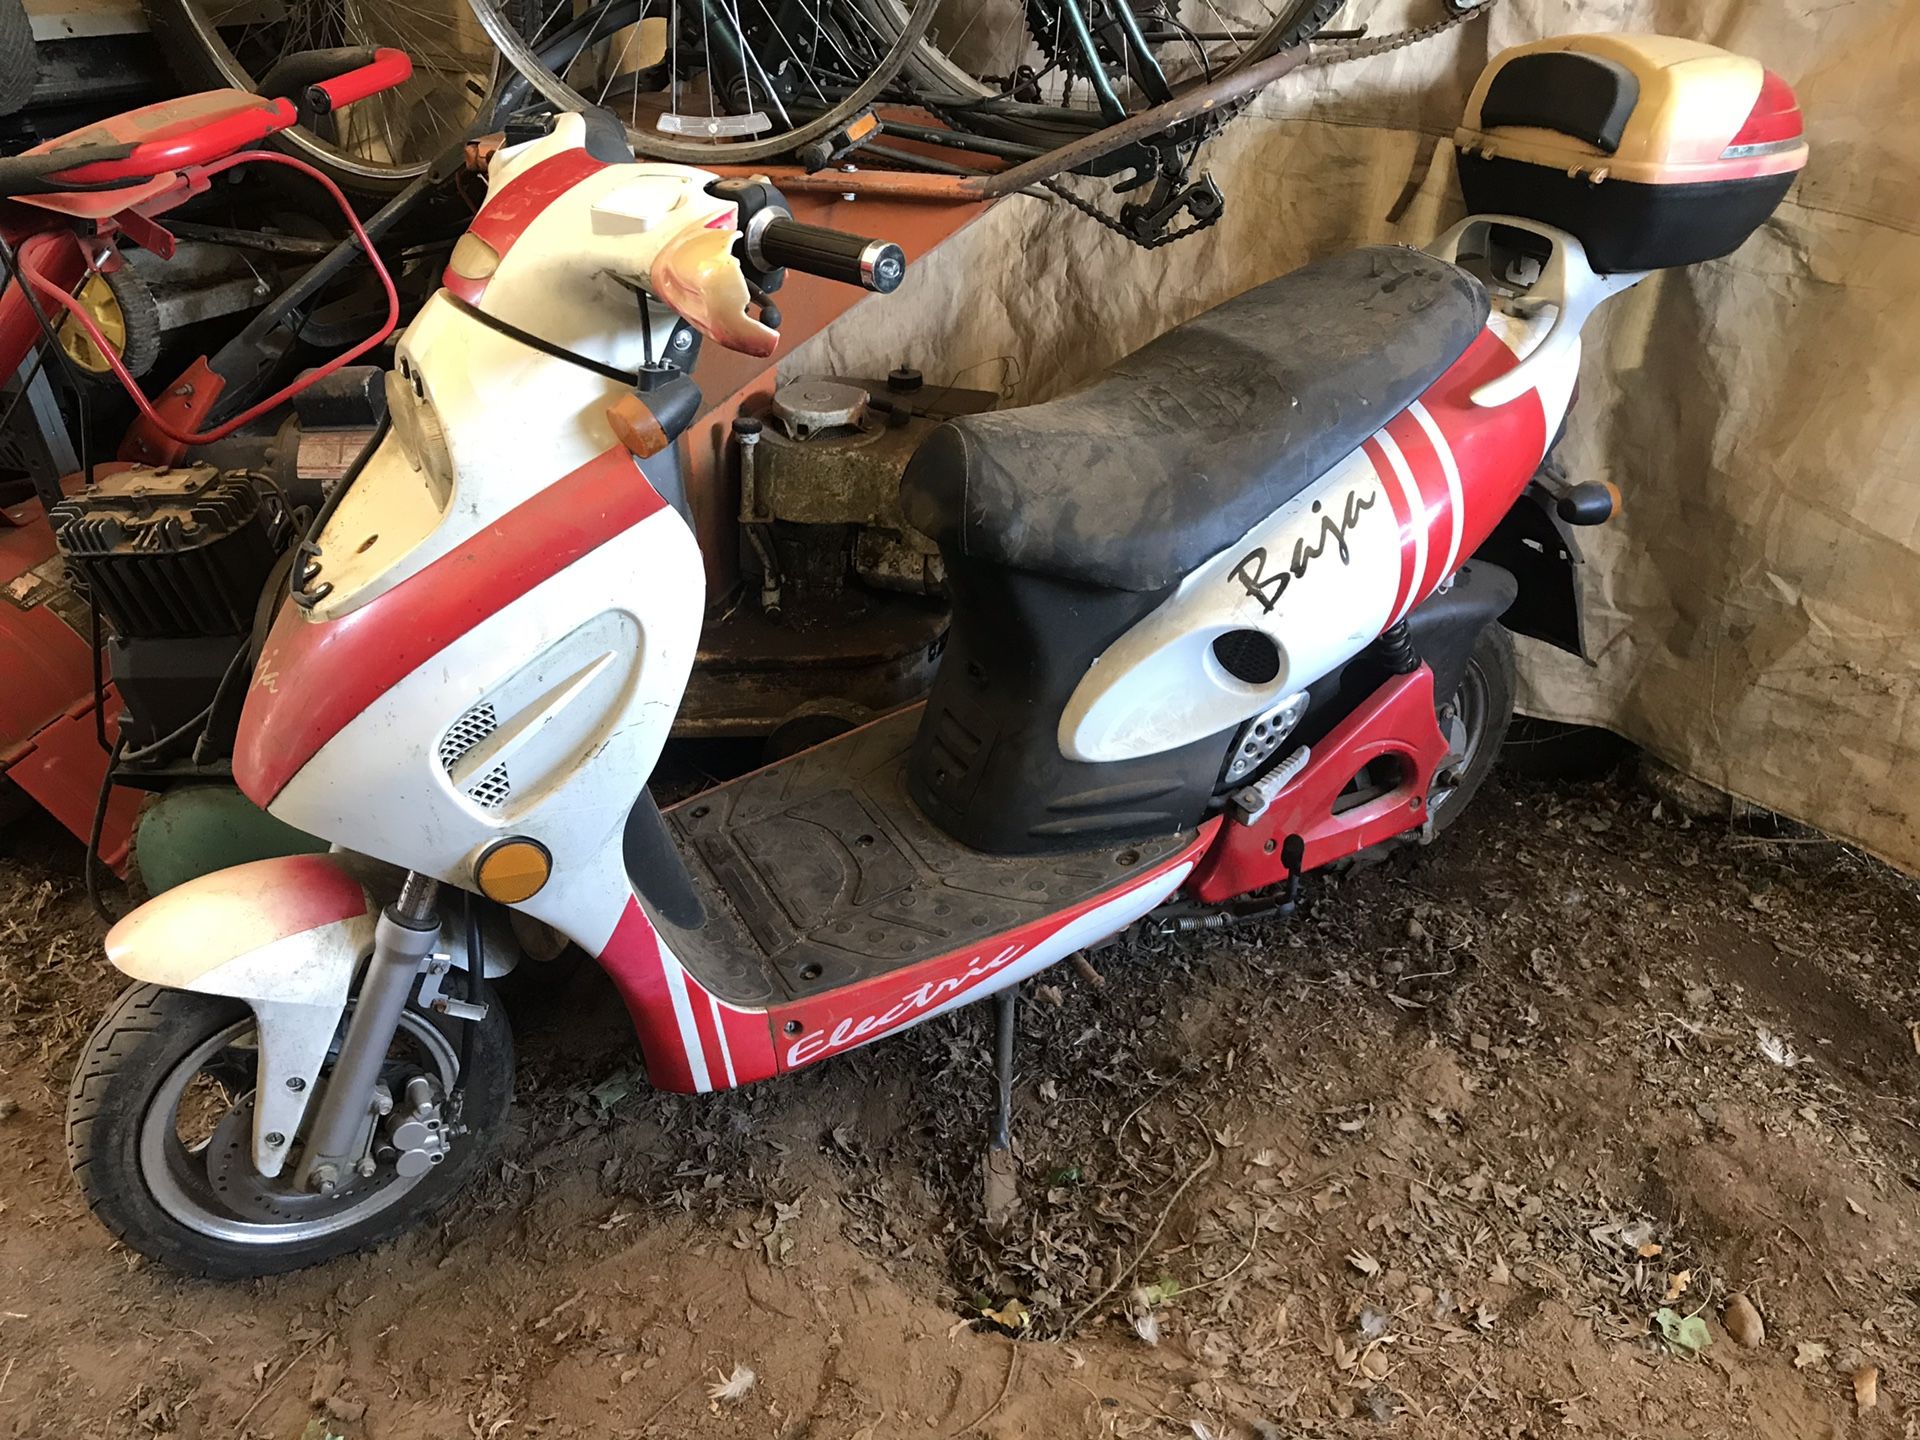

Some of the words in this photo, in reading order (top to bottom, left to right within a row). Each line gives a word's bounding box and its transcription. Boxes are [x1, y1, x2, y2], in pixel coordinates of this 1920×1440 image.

[1227, 490, 1376, 615] Baja
[253, 649, 279, 694] ja
[787, 944, 1025, 1067] Electric
